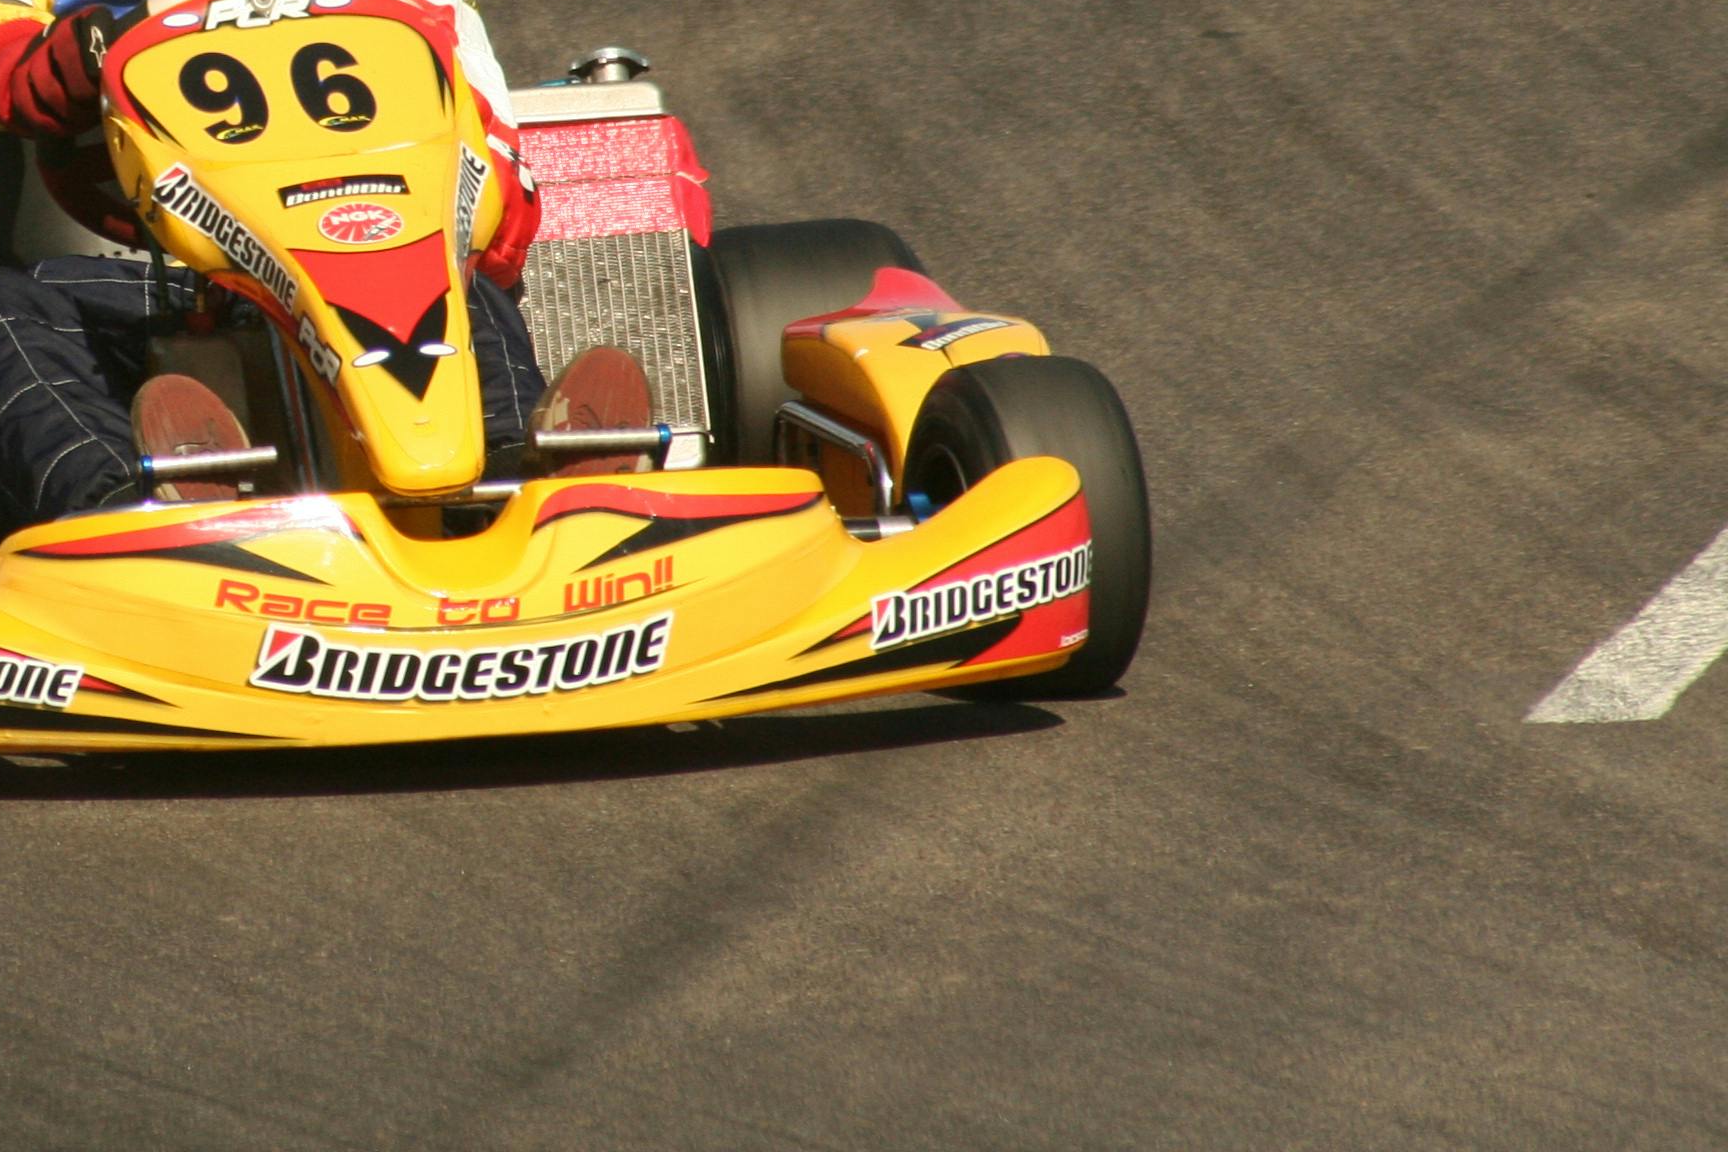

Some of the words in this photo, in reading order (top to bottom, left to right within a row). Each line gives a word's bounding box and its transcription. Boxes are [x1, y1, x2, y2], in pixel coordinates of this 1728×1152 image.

[152, 164, 298, 313] BRIDGESTONE
[329, 209, 385, 226] NGK
[215, 579, 392, 627] Race
[435, 597, 519, 625] to
[250, 614, 672, 699] BRIDGESTONE
